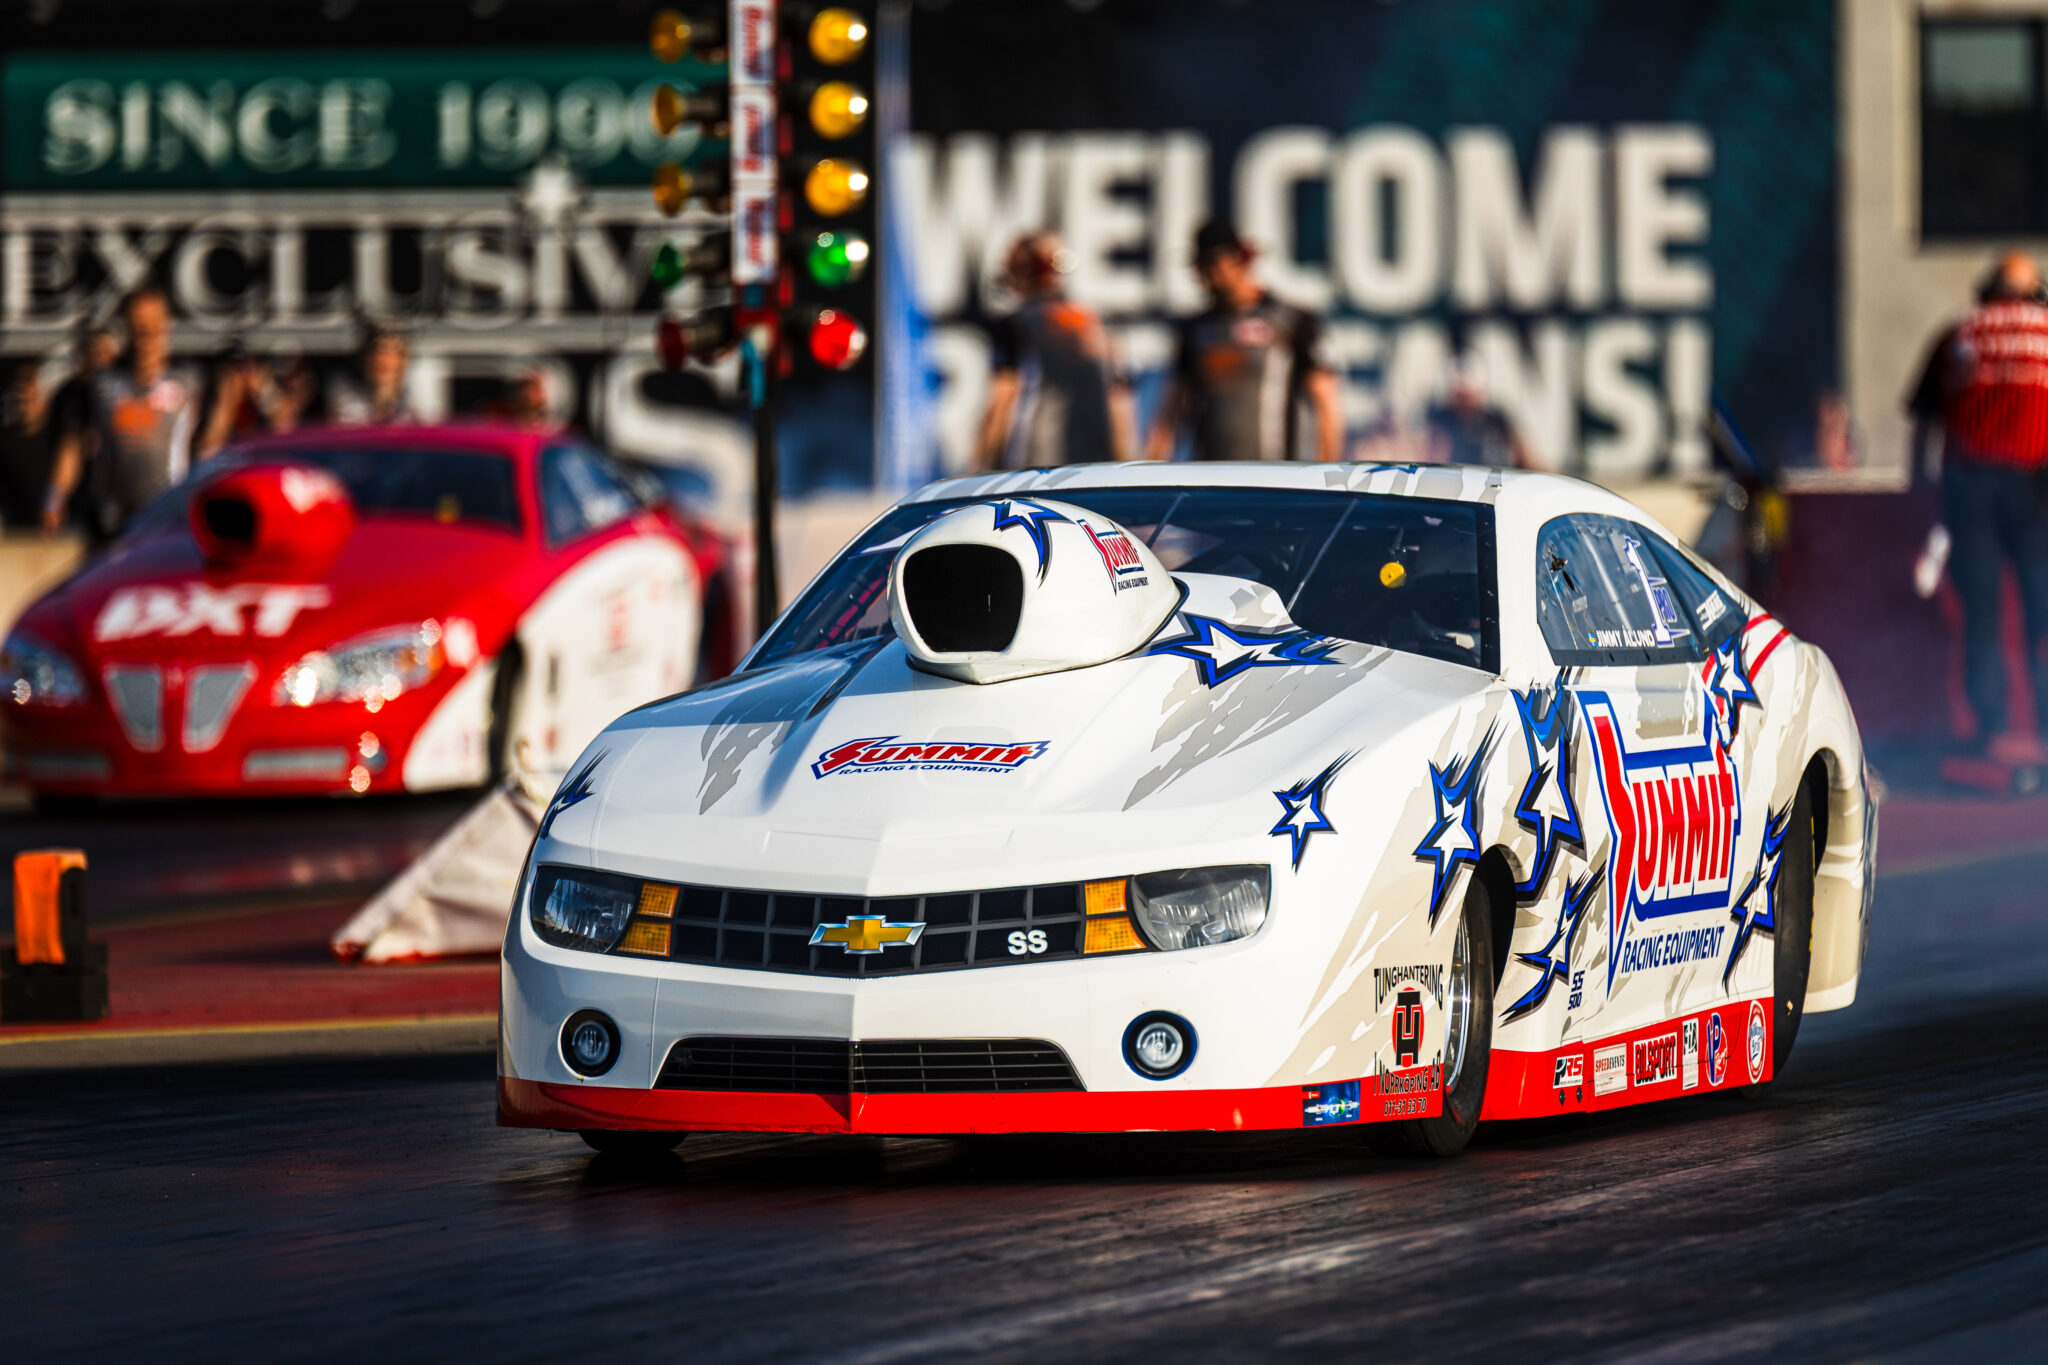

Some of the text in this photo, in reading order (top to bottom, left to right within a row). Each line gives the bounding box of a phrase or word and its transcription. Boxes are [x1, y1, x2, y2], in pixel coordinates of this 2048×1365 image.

[45, 78, 398, 172] SINCE
[885, 123, 1714, 316] WELCOME
[1596, 630, 1623, 648] JIMMY
[816, 738, 1044, 776] SUMMIT
[838, 763, 1015, 775] RACING EQUIPMENT
[1007, 929, 1048, 955] SS
[1621, 925, 1725, 974] RACING EQUIPMENT
[1373, 964, 1443, 1013] TUNGHANTERING
[1378, 1059, 1428, 1095] NORRKÖPING
[1429, 1049, 1441, 1091] AB
[1635, 1035, 1676, 1084] BILSPORT
[1384, 1097, 1427, 1116] 011-31 33 70
